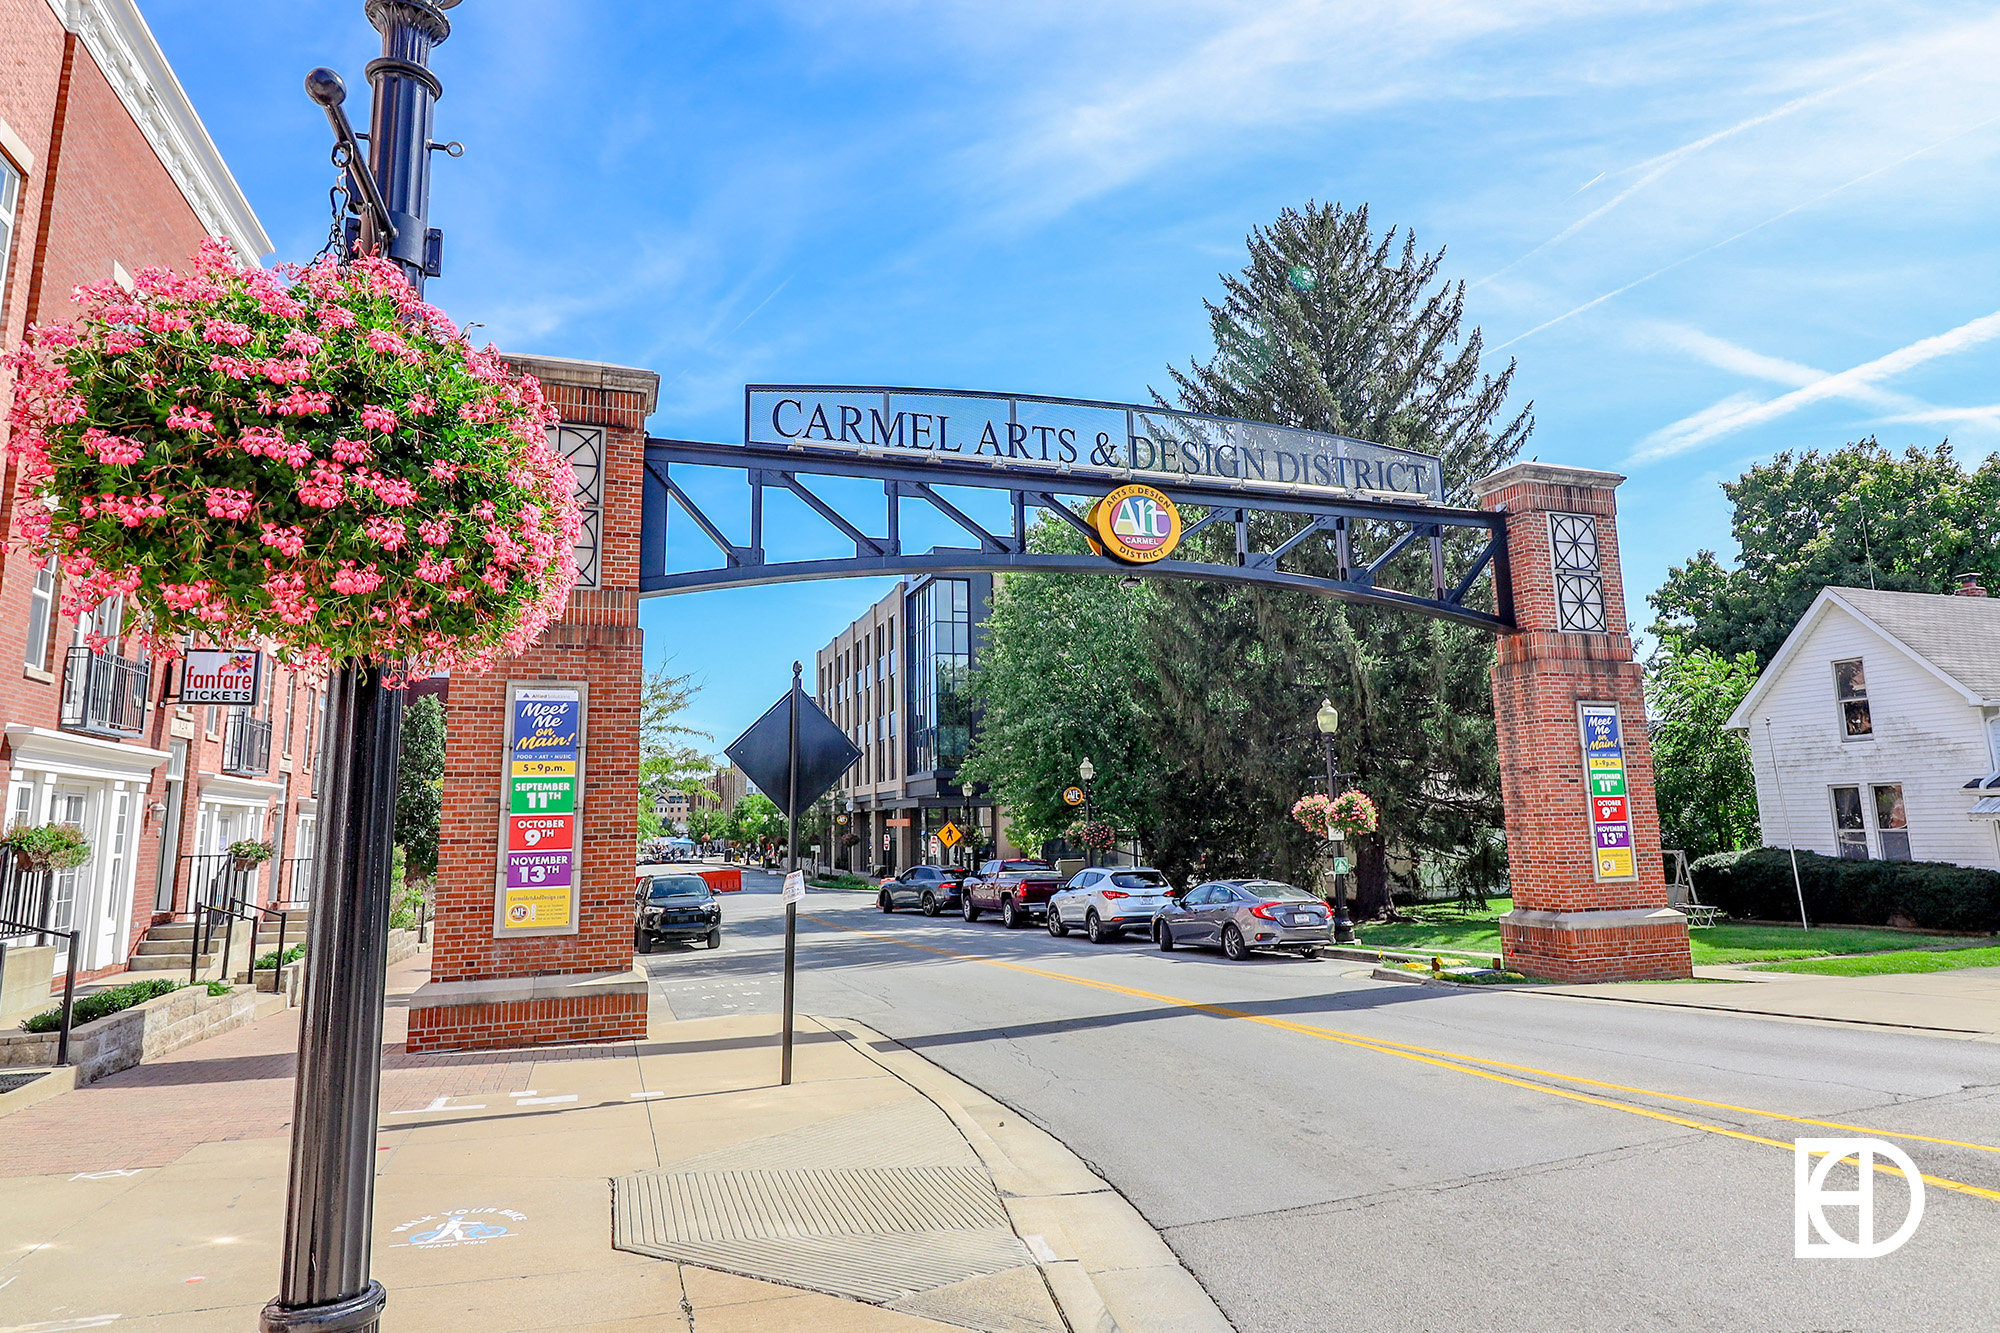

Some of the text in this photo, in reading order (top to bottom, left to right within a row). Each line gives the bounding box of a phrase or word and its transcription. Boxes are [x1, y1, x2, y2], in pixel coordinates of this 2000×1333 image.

[771, 399, 1427, 494] CARMEL ARTS & DESIGN DISTRICT
[1106, 486, 1171, 509] ARTS & DESIGN
[1113, 498, 1168, 537] Art
[1125, 536, 1159, 545] CARMEL
[1119, 546, 1164, 559] DISTRICT
[186, 665, 252, 690] fanfare
[185, 690, 250, 701] TICKETS
[520, 702, 570, 718] Meet
[532, 715, 563, 729] Me
[1588, 716, 1613, 728] Meet
[535, 728, 555, 737] on
[1594, 725, 1611, 735] Me
[515, 732, 576, 751] Main!
[1589, 738, 1619, 751] Main!
[515, 782, 571, 792] SEPTEMBER
[526, 792, 562, 809] 11TH
[517, 819, 565, 829] OCTOBER
[524, 829, 555, 847] 9TH
[510, 855, 568, 866] NOVEMBER
[518, 865, 560, 883] 13TH
[440, 1207, 498, 1216] YOUR
